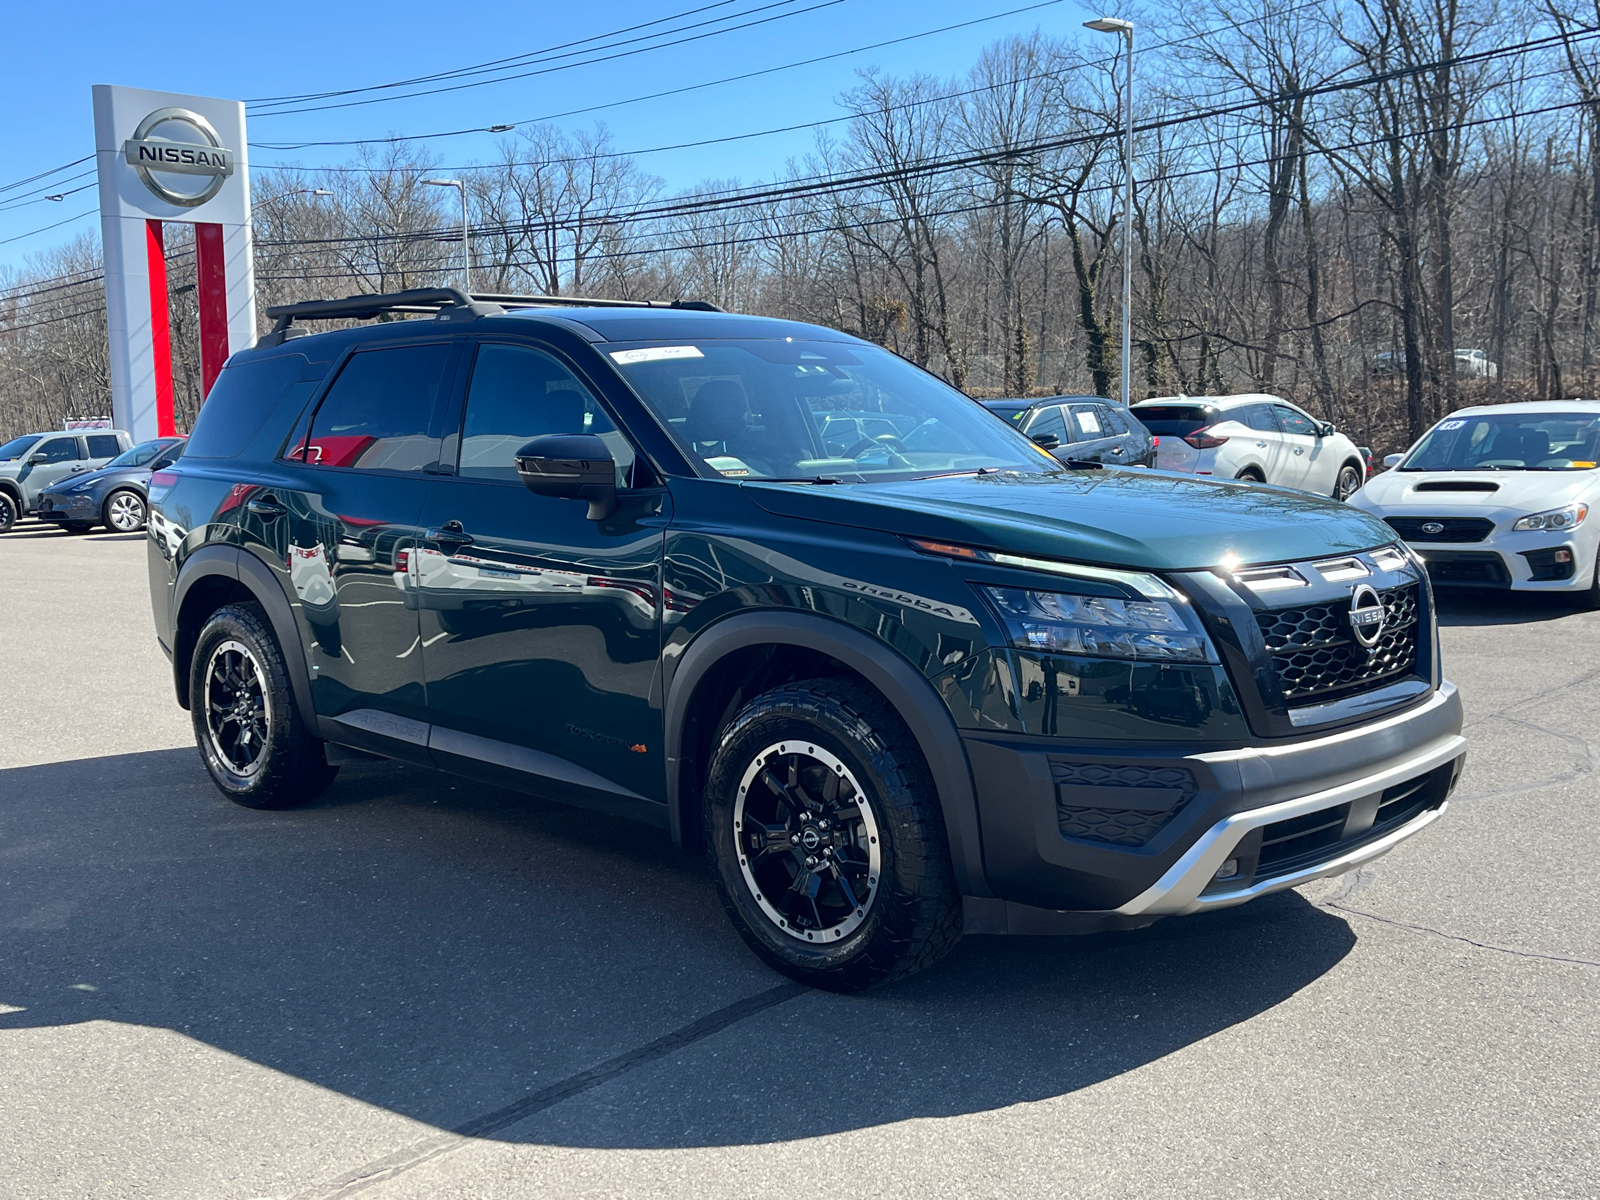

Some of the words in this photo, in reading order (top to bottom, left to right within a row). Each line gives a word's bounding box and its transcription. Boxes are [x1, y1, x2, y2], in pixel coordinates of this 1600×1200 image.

[139, 146, 226, 169] NISSAN
[354, 713, 424, 739] PATHFINDER
[735, 718, 790, 751] TIRES
